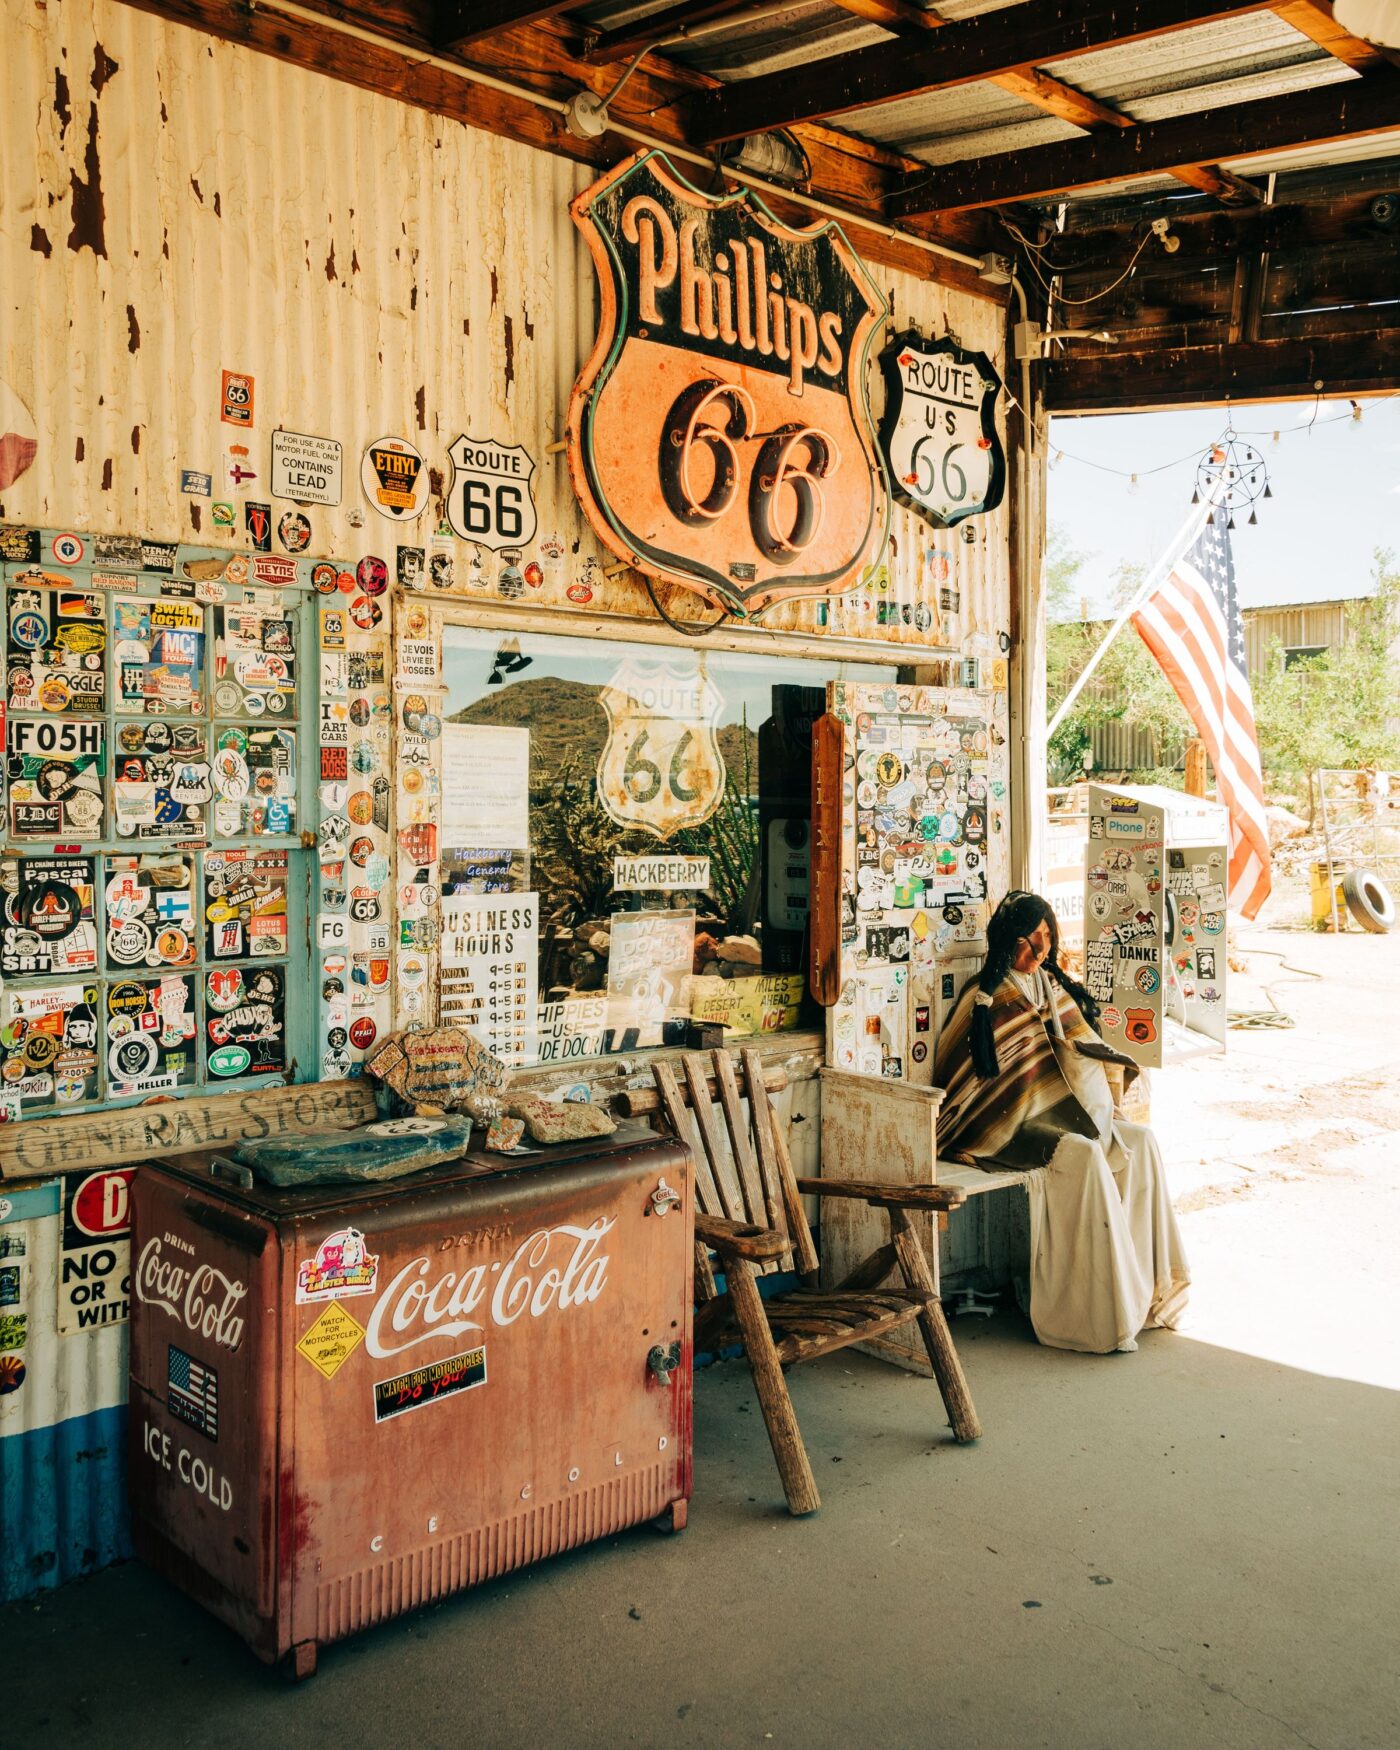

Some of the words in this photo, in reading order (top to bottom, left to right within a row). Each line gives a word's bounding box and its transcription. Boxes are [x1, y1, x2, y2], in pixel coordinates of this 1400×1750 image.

[621, 195, 843, 397] Phillips
[908, 359, 974, 400] ROUTE
[228, 389, 246, 403] 66
[283, 436, 298, 445] FOR
[300, 438, 313, 448] USE
[316, 442, 325, 450] AS
[275, 444, 301, 455] MOTOR
[303, 449, 320, 458] FUEL
[323, 452, 339, 462] ONLY
[463, 447, 521, 474] ROUTE
[282, 458, 334, 475] CONTAINS
[375, 452, 418, 477] ETHYL
[658, 378, 841, 566] 66
[911, 435, 967, 501] 66
[288, 471, 327, 490] LEAD
[285, 488, 329, 501] (TETRAETHYL)
[463, 480, 522, 538] 66
[326, 621, 341, 632] 66
[403, 645, 413, 654] JE
[414, 646, 434, 655] VOIS
[412, 657, 423, 665] VIE
[403, 665, 435, 676] VOSGES
[626, 687, 702, 710] ROUTE
[321, 704, 331, 719] I
[321, 722, 347, 732] ART
[376, 731, 387, 739] 66
[321, 732, 348, 741] CARS
[405, 736, 427, 744] WILD
[321, 748, 346, 759] RED
[321, 760, 347, 777] DOGS
[623, 729, 709, 804] 66
[176, 776, 206, 790] A&K
[1109, 820, 1143, 832] Phone
[454, 848, 512, 864] Hackberry
[25, 868, 88, 881] Pascal
[208, 861, 223, 871] 66
[467, 864, 510, 876] General
[617, 863, 707, 885] HACKBERRY
[355, 900, 376, 917] 66
[1050, 896, 1084, 917] ENER
[441, 908, 532, 933] BUSINESS
[322, 922, 344, 939] FG
[124, 937, 135, 946] 66
[370, 937, 386, 948] 66
[455, 933, 514, 958] HOURS
[1119, 945, 1158, 962] DANKE
[3, 956, 51, 971] SRT
[441, 967, 470, 979] ONDAY
[489, 963, 512, 977] 9-5
[441, 983, 475, 995] UESDAY
[489, 980, 512, 993] 9-5
[754, 977, 789, 993] MILES
[489, 996, 512, 1008] 9-5
[703, 997, 744, 1013] DESERT
[759, 993, 791, 1007] AHEAD
[489, 1011, 512, 1023] 9-5
[537, 1001, 604, 1023] HIPPIES
[761, 1007, 787, 1030] ICE
[552, 1021, 584, 1038] USE
[489, 1042, 512, 1055] 9-5
[538, 1040, 561, 1061] IDE
[562, 1036, 599, 1059] DOOR
[137, 1079, 173, 1090] HELLER
[15, 1106, 228, 1172] GENERAL
[240, 1088, 367, 1140] STORE
[103, 1176, 128, 1227] D
[163, 1231, 196, 1256] DRINK
[438, 1221, 514, 1252] DRINK
[62, 1249, 117, 1284] NO
[70, 1282, 106, 1306] OR
[134, 1236, 249, 1350] Coca-Cola
[365, 1214, 618, 1359] Coca-Cola
[320, 1317, 345, 1327] WATCH
[325, 1325, 340, 1333] FOR
[305, 1330, 358, 1346] MOTORCYCLES
[382, 1376, 411, 1399] WATCH
[411, 1369, 428, 1388] FOR
[429, 1350, 484, 1381] MOTORCYCLES
[144, 1421, 172, 1472] ICE
[178, 1448, 233, 1511] COLD
